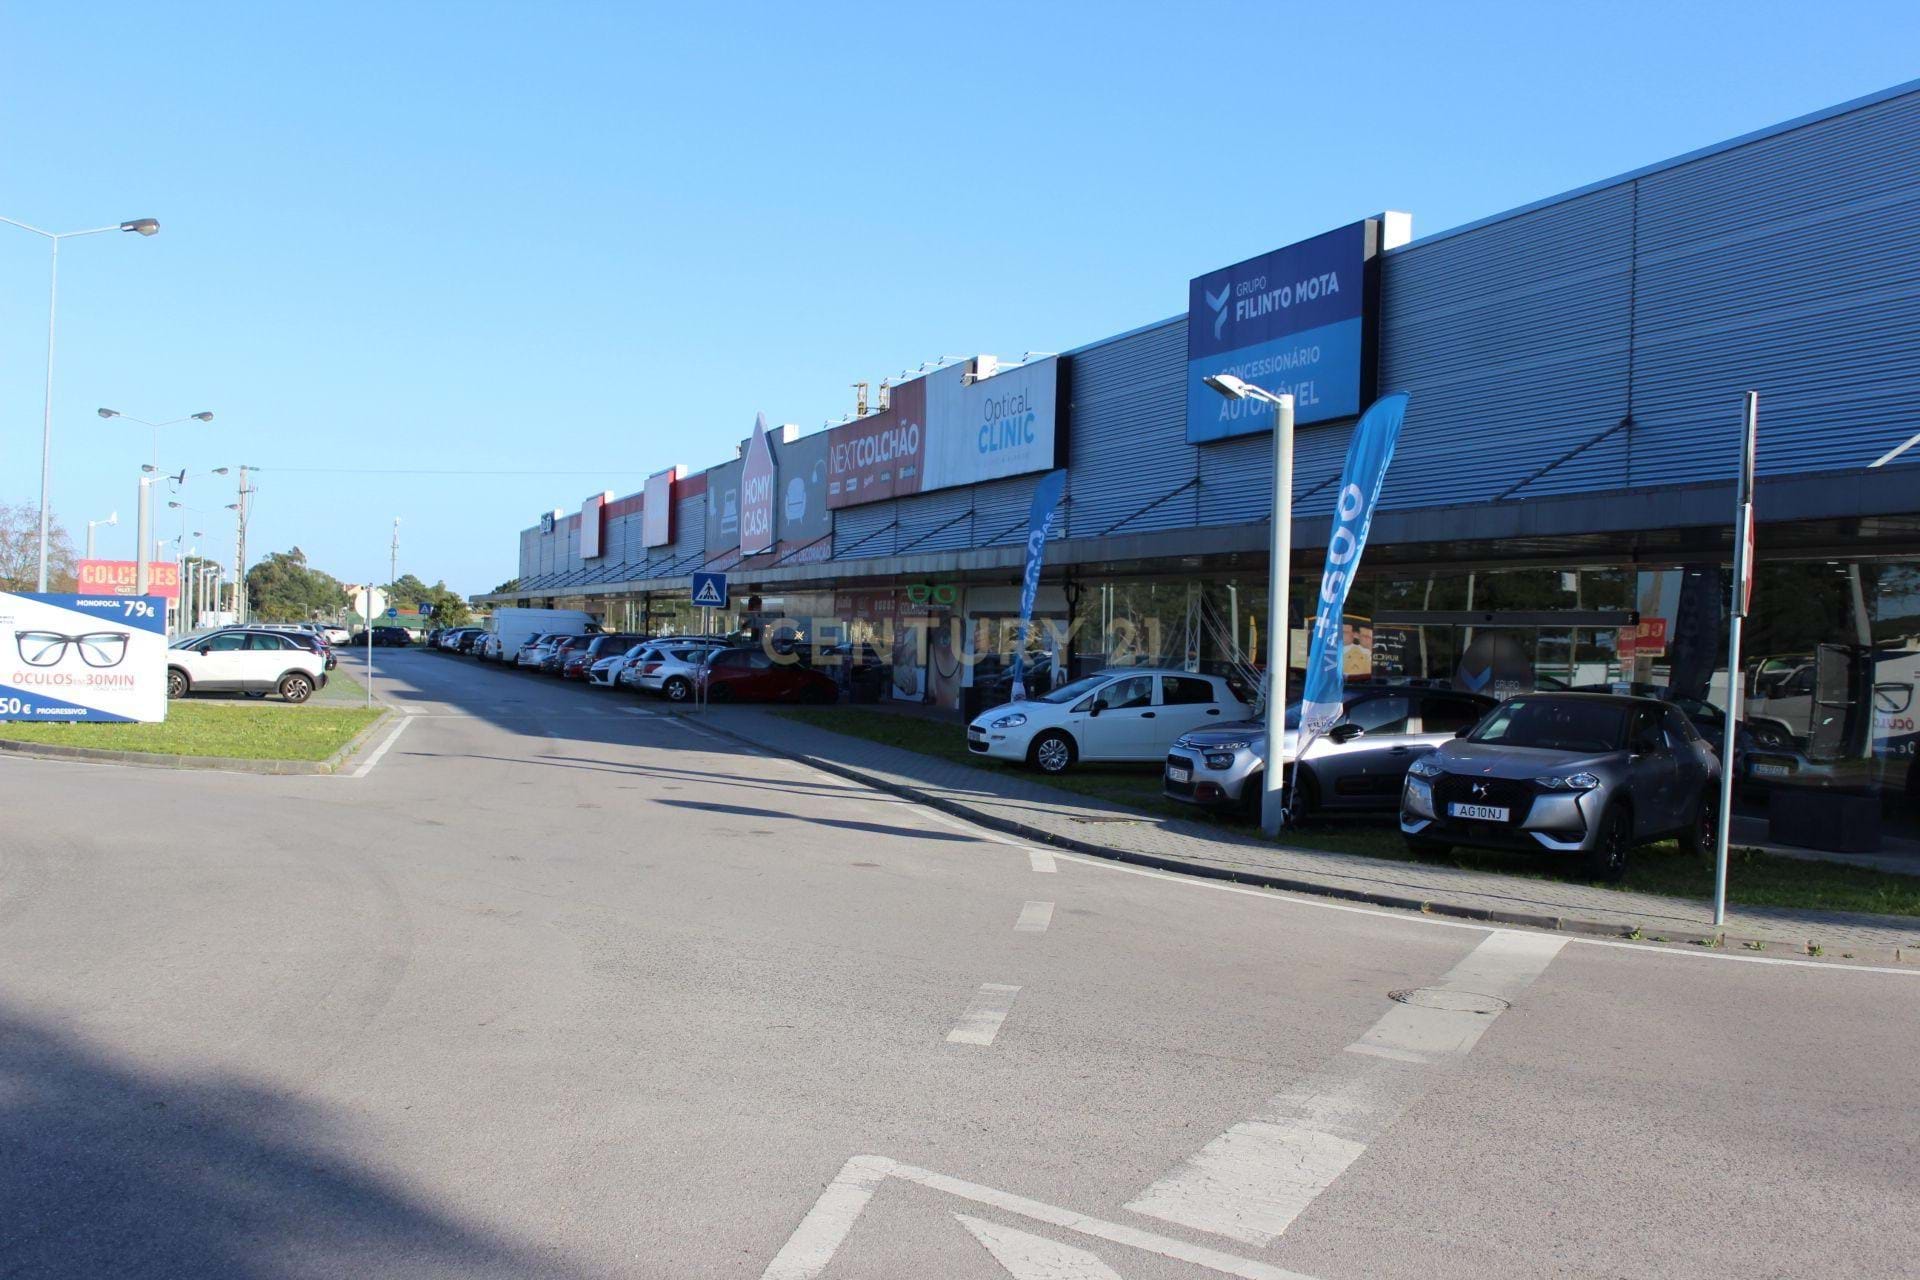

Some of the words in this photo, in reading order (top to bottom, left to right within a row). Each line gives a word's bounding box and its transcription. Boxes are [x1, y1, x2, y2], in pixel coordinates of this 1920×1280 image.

[1236, 276, 1267, 297] GRUPO
[1236, 286, 1292, 322] FILINTO
[1295, 272, 1340, 304] MOTA
[978, 412, 1036, 454] CLINIC
[744, 474, 770, 505] HOMY
[743, 508, 769, 537] CASA
[76, 599, 121, 608] MONOFOCAL
[124, 600, 155, 618] 79€
[12, 670, 73, 685] ÓCULOS
[86, 674, 135, 687] 30MIN
[36, 707, 88, 715] PROGRESSIVOS
[1459, 804, 1502, 820] AG10NJ
